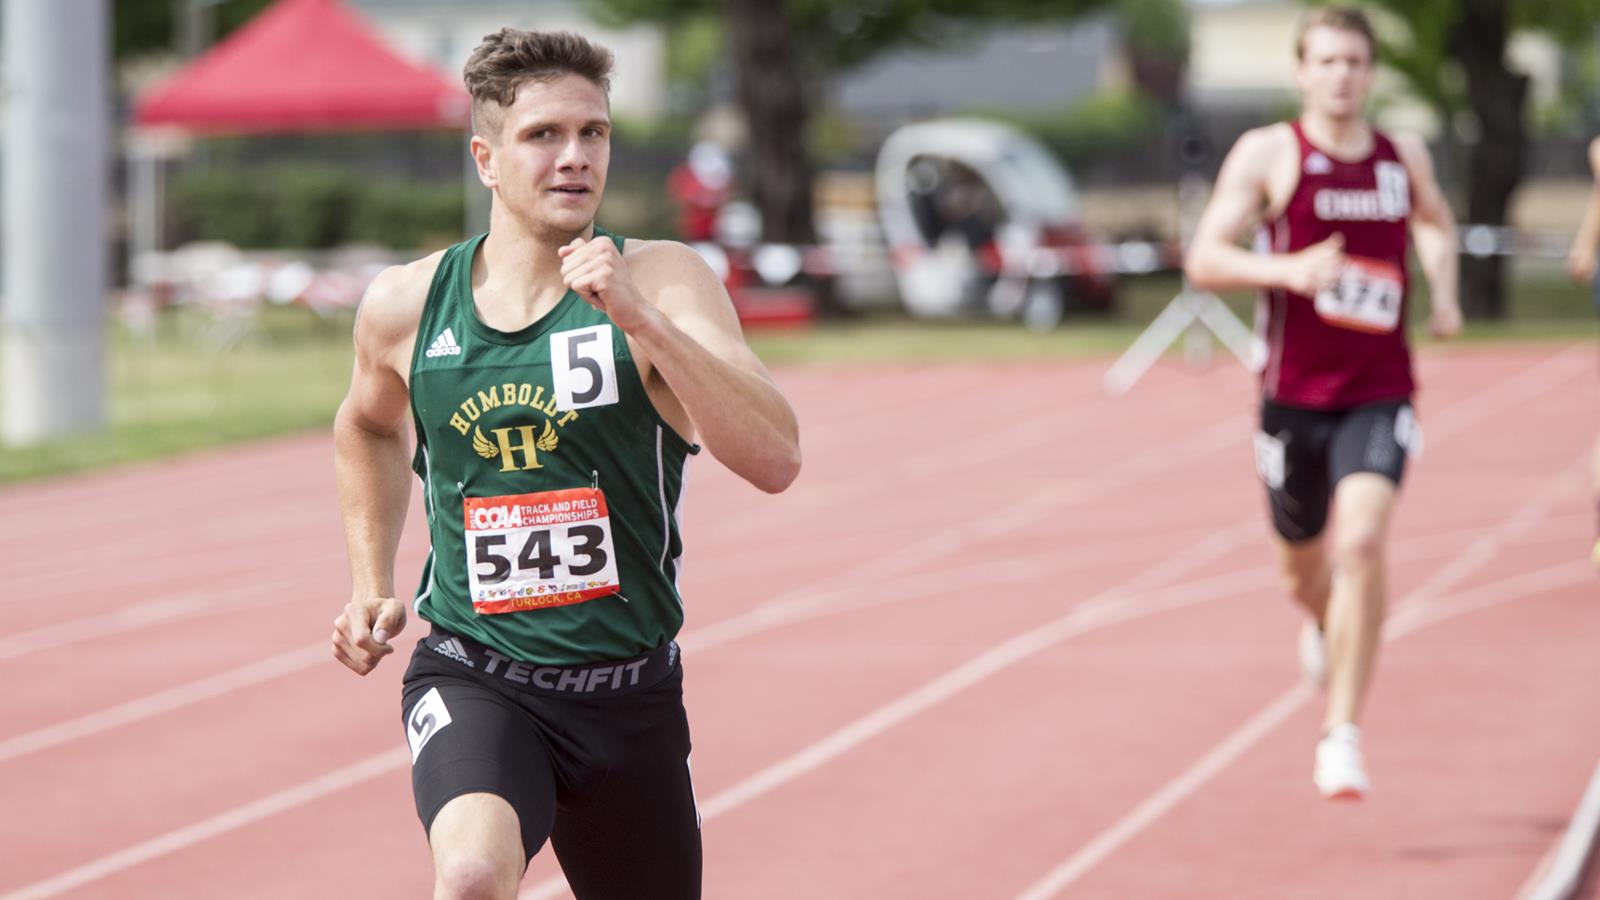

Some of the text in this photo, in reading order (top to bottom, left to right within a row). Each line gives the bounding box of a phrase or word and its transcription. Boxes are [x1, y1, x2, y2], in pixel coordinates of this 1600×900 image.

[426, 345, 461, 358] adidas
[568, 332, 603, 404] 5
[449, 383, 580, 436] HUMBOLDT
[491, 425, 544, 472] H
[521, 498, 597, 515] TRACK AND FIELD
[522, 508, 599, 526] CHAMPIONSHIPS
[475, 524, 608, 585] 543
[567, 590, 582, 600] CA
[483, 649, 649, 693] TECHFIT
[411, 700, 437, 750] 5
